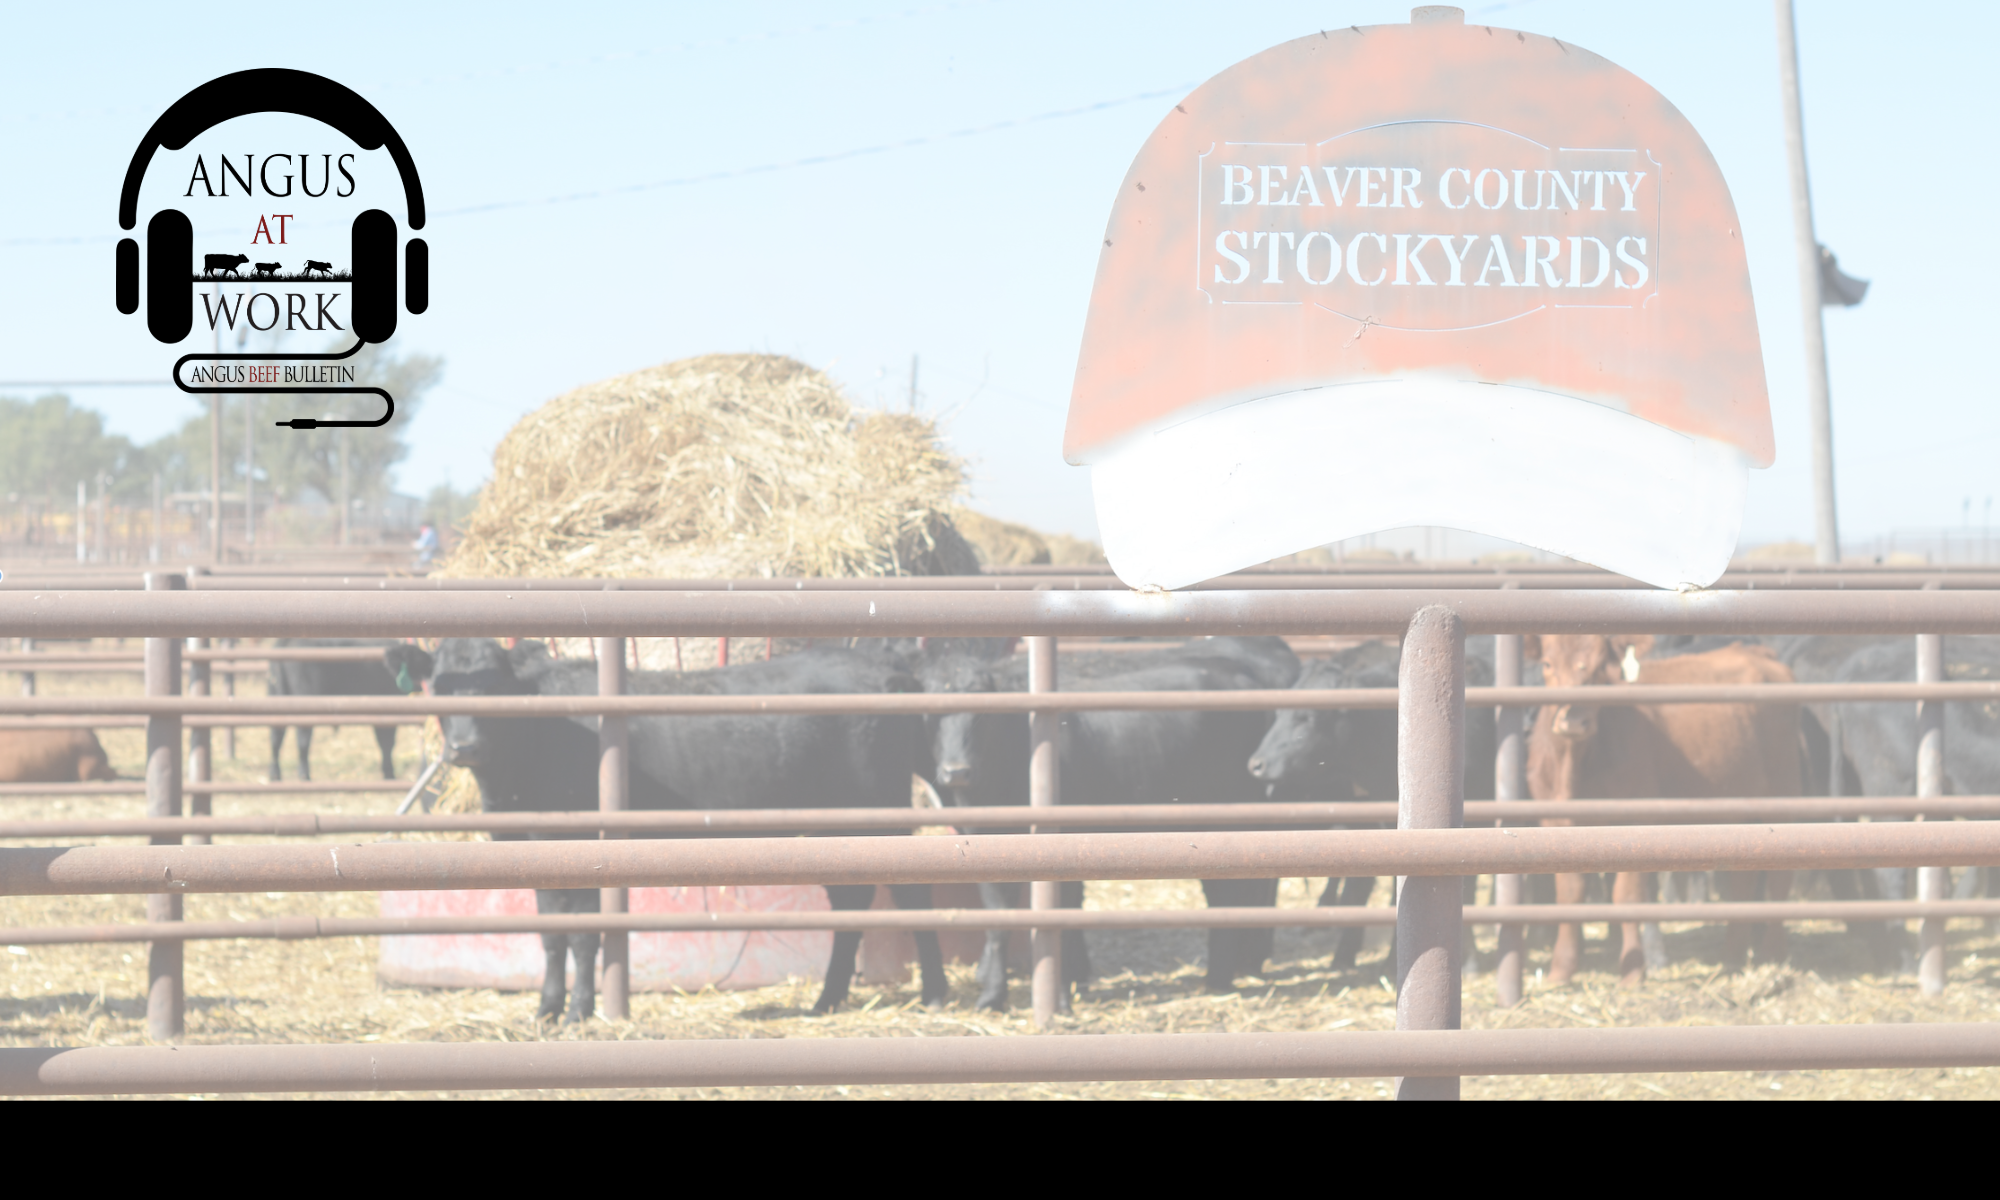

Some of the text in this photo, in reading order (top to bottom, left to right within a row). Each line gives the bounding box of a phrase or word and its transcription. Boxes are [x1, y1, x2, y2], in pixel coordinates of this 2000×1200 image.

[1220, 163, 1648, 212] BEAVER COUNTY
[1214, 229, 1650, 290] STOCKYARDS
